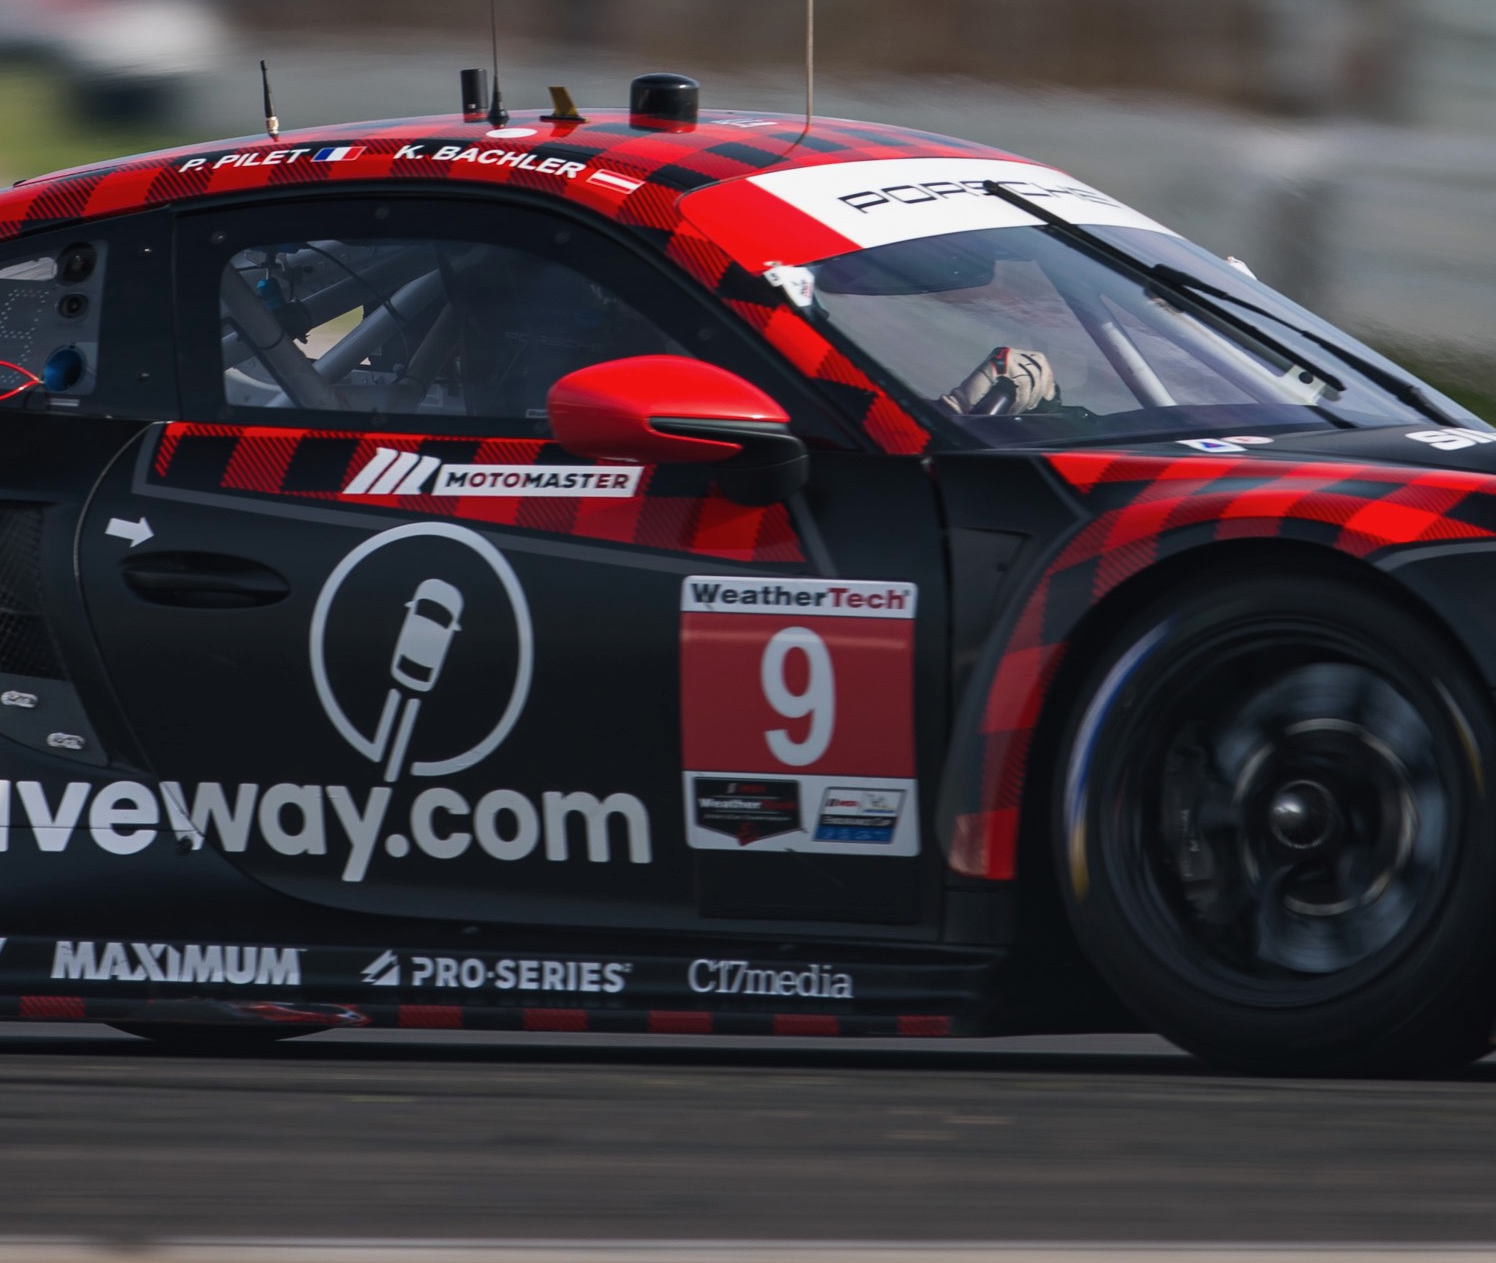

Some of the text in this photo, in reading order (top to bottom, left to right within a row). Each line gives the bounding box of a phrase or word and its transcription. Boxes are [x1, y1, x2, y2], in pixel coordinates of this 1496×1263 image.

[179, 148, 311, 173] P. PILET
[392, 144, 587, 180] K. BACHLER
[446, 470, 631, 490] MOTOMASTER
[691, 583, 906, 610] WeatherTech
[761, 626, 836, 767] 9
[51, 940, 302, 985] MAXIMUM
[688, 958, 855, 998] C17media
